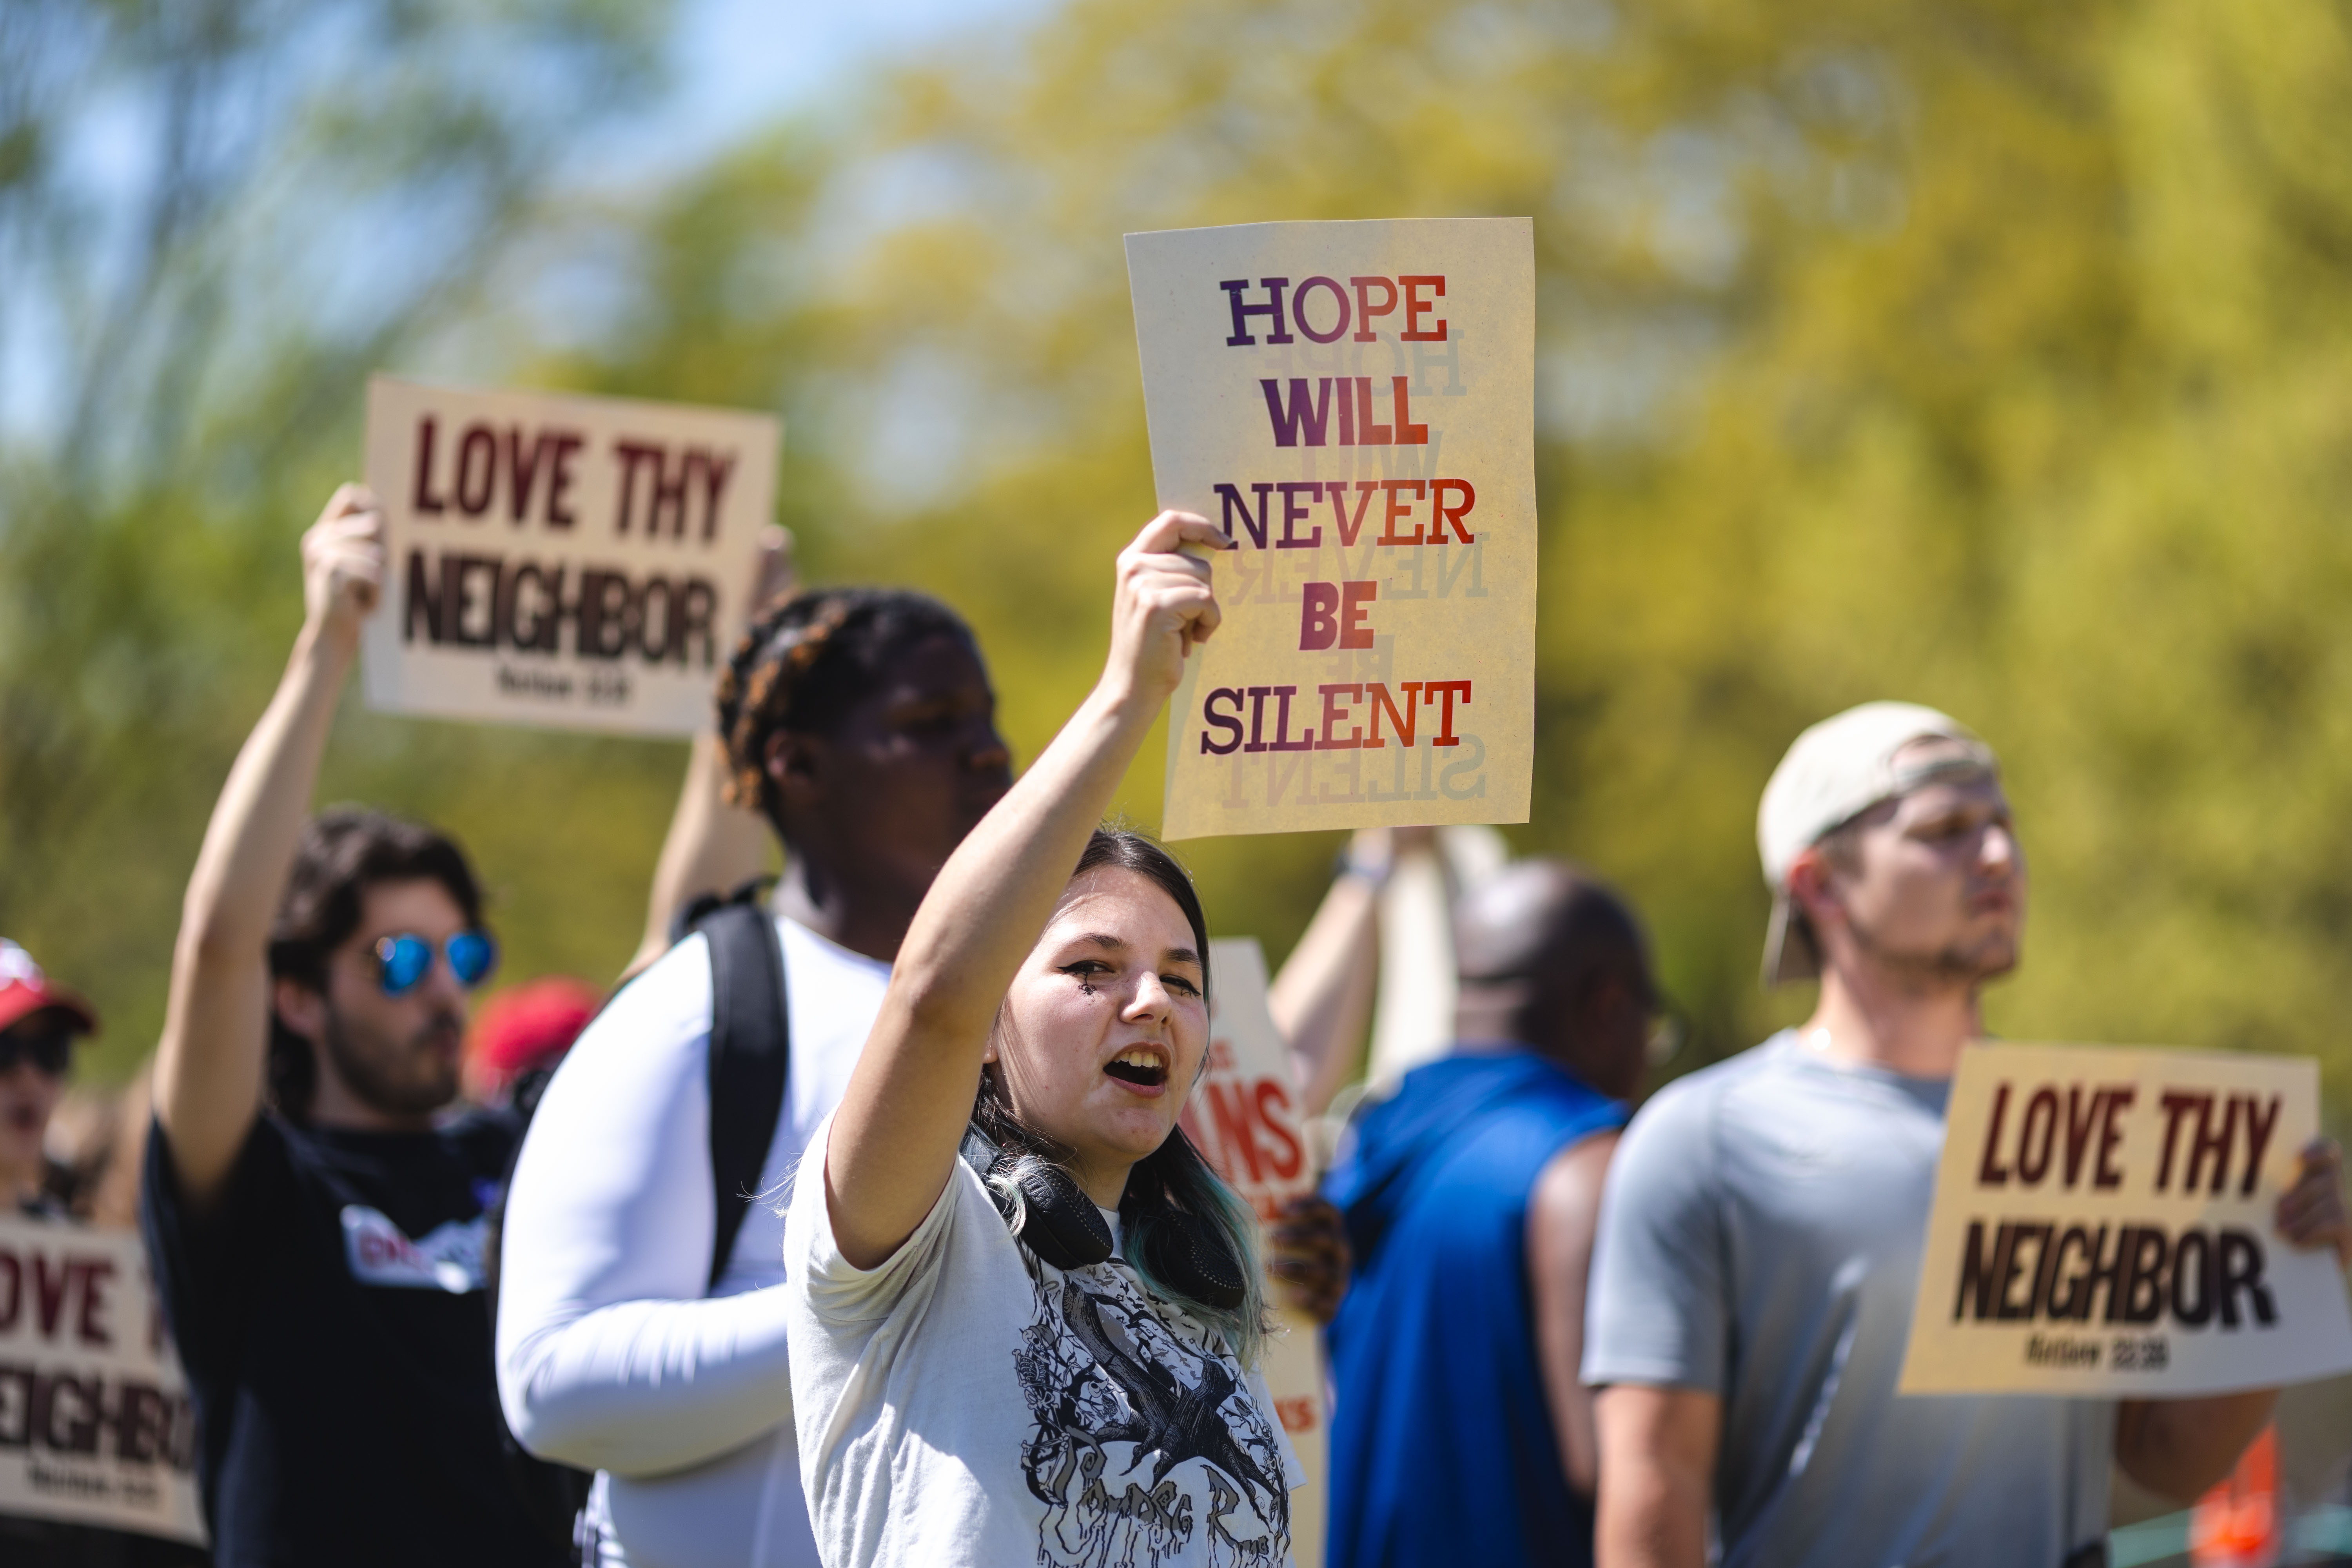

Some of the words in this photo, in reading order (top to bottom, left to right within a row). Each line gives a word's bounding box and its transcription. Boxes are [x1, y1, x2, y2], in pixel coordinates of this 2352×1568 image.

[1220, 275, 1447, 346] HOPE
[1259, 376, 1428, 447] WILL
[414, 411, 584, 528] LOVE
[614, 435, 737, 539] THY
[1214, 479, 1475, 550] NEVER
[405, 550, 716, 669] NEIGHBOR
[1299, 581, 1377, 650] BE
[1200, 680, 1472, 755] SILENT
[1978, 1081, 2136, 1191] LOVE
[2155, 1089, 2283, 1199] THY
[1953, 1218, 2279, 1329] NEIGHBOR
